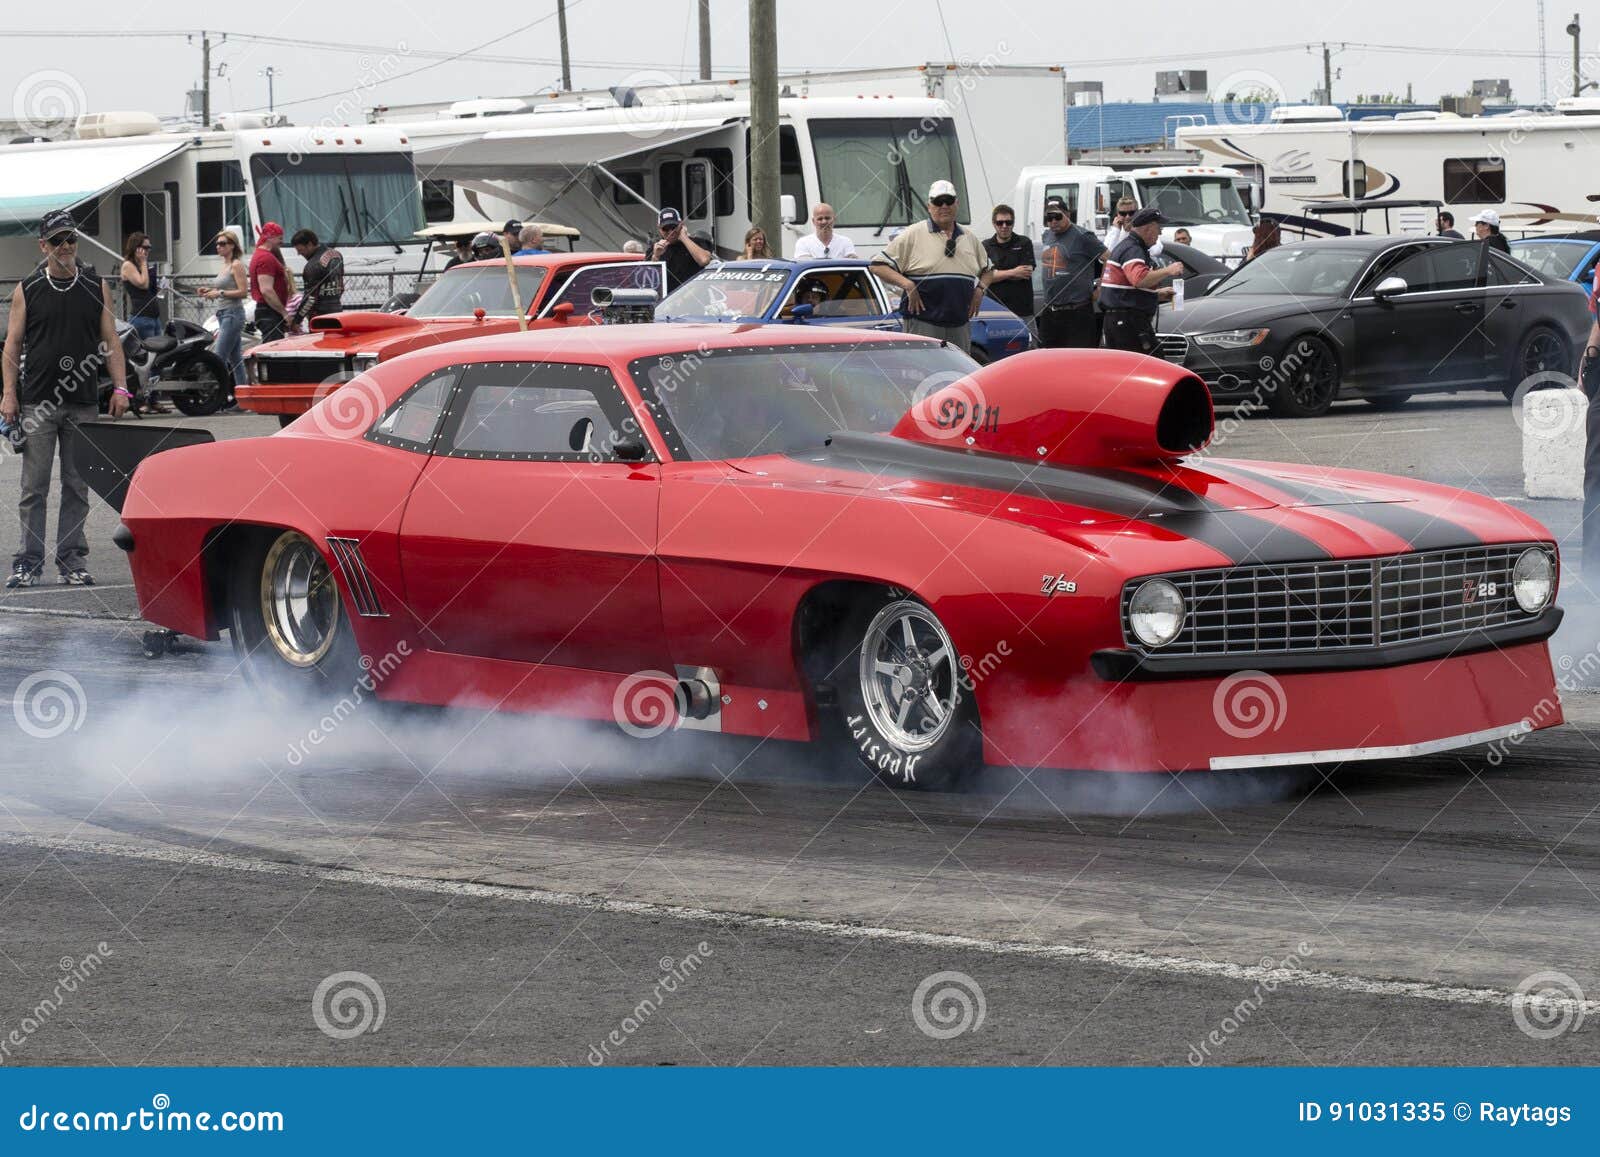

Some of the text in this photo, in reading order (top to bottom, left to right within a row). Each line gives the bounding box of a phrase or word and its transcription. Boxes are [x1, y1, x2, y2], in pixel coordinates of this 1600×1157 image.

[706, 271, 764, 281] RENAUD
[766, 273, 784, 282] 25
[937, 398, 1000, 433] SP 911
